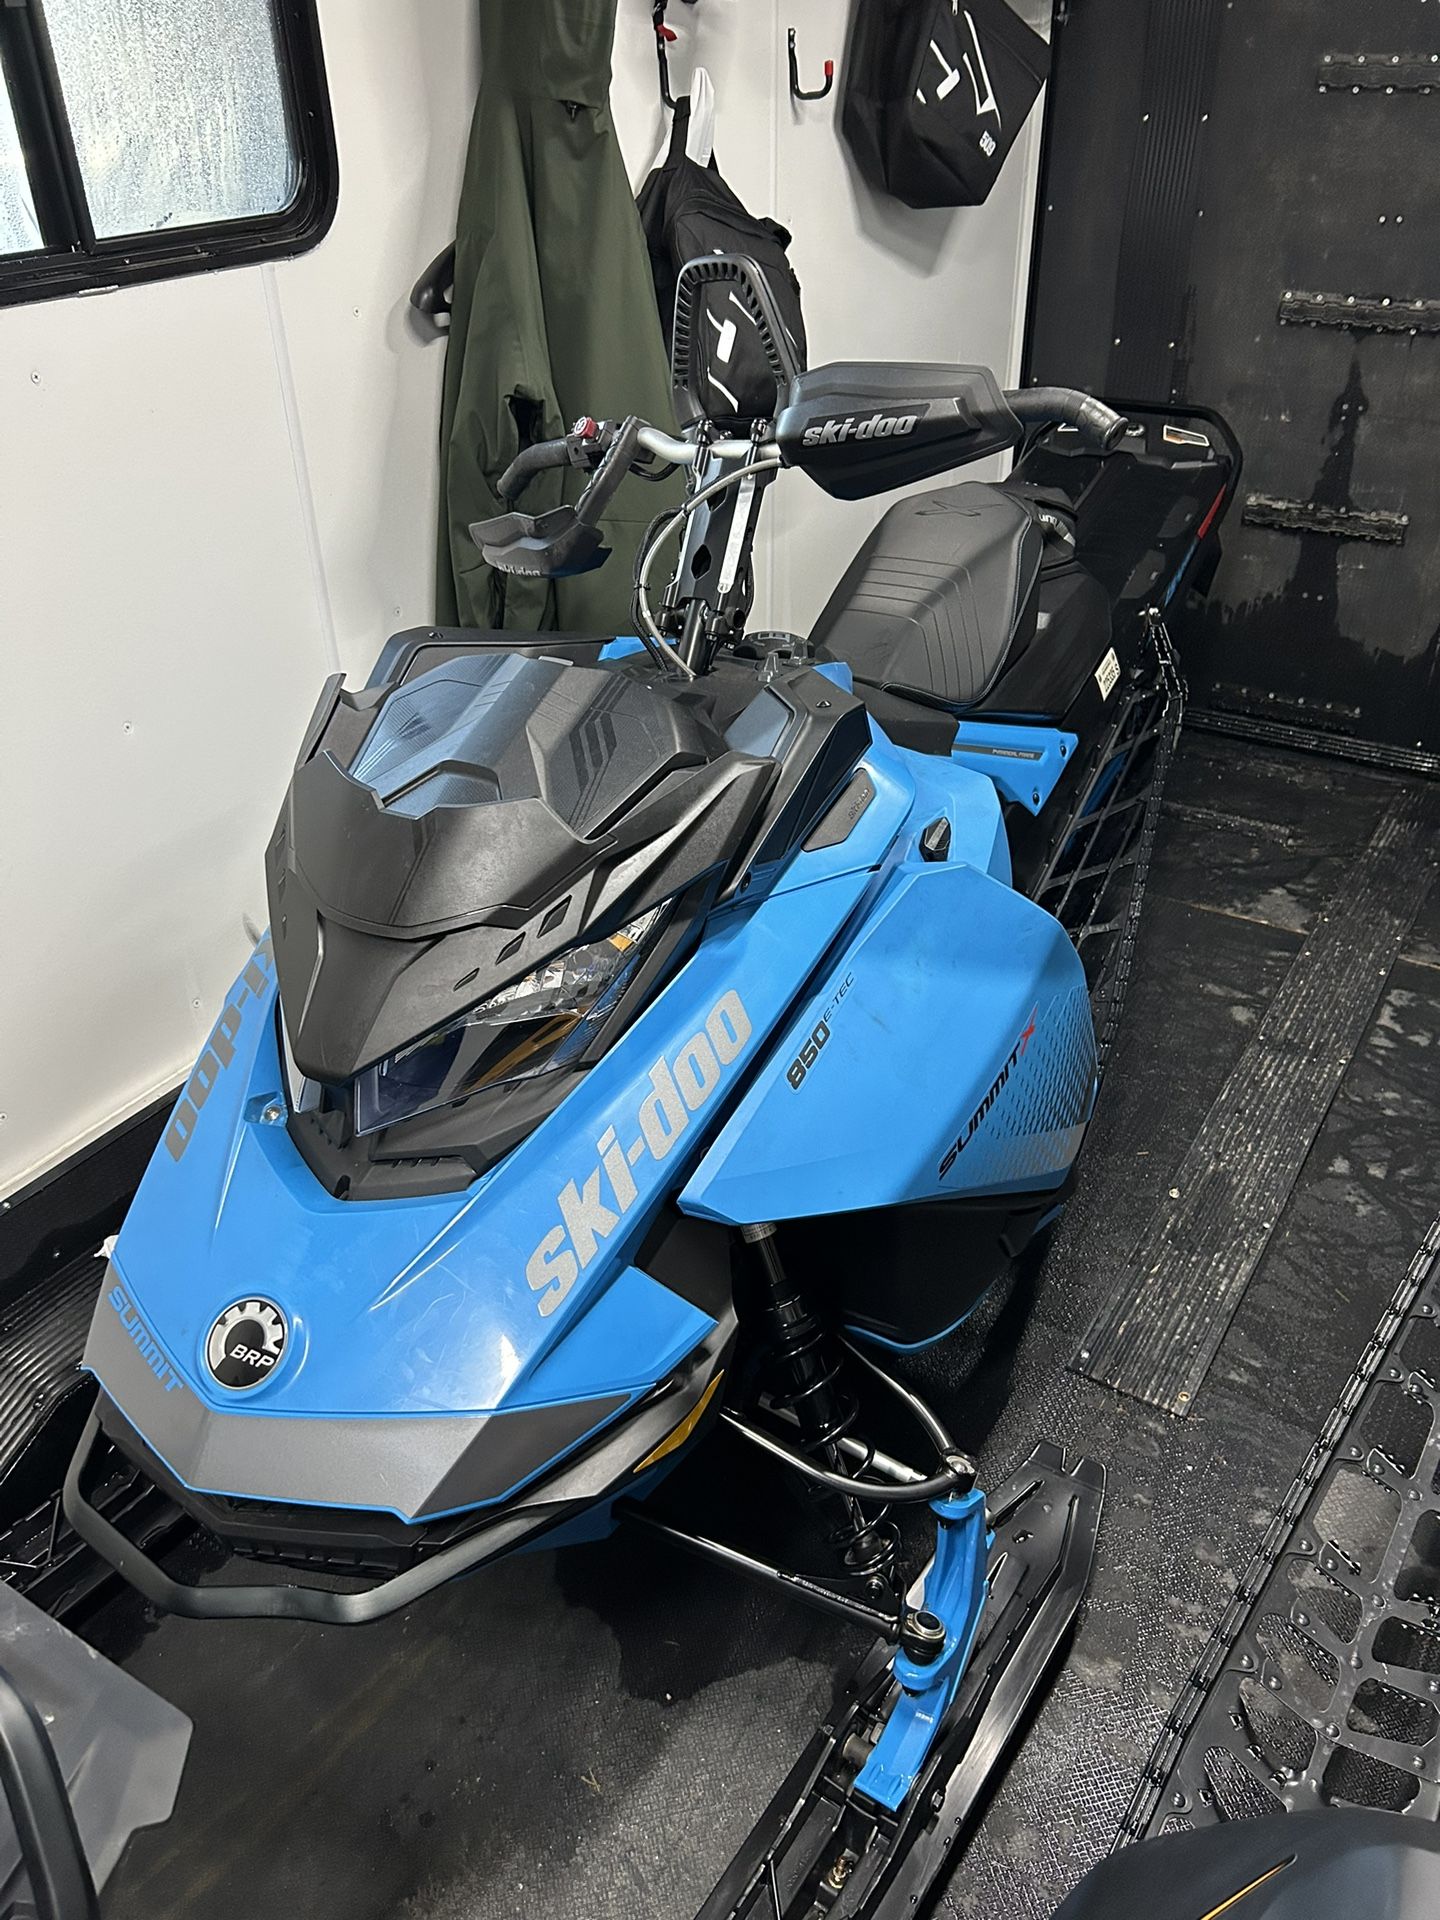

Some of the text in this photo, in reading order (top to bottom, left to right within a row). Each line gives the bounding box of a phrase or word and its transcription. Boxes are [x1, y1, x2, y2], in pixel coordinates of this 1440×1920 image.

[979, 130, 996, 157] 509
[802, 413, 918, 446] ski-doo
[786, 971, 854, 1090] 850 E-TEC
[525, 989, 753, 1318] ski-doo
[939, 1041, 1021, 1181] SUMMIT
[108, 1286, 185, 1392] SUMMIT
[229, 1343, 276, 1368] BRP
